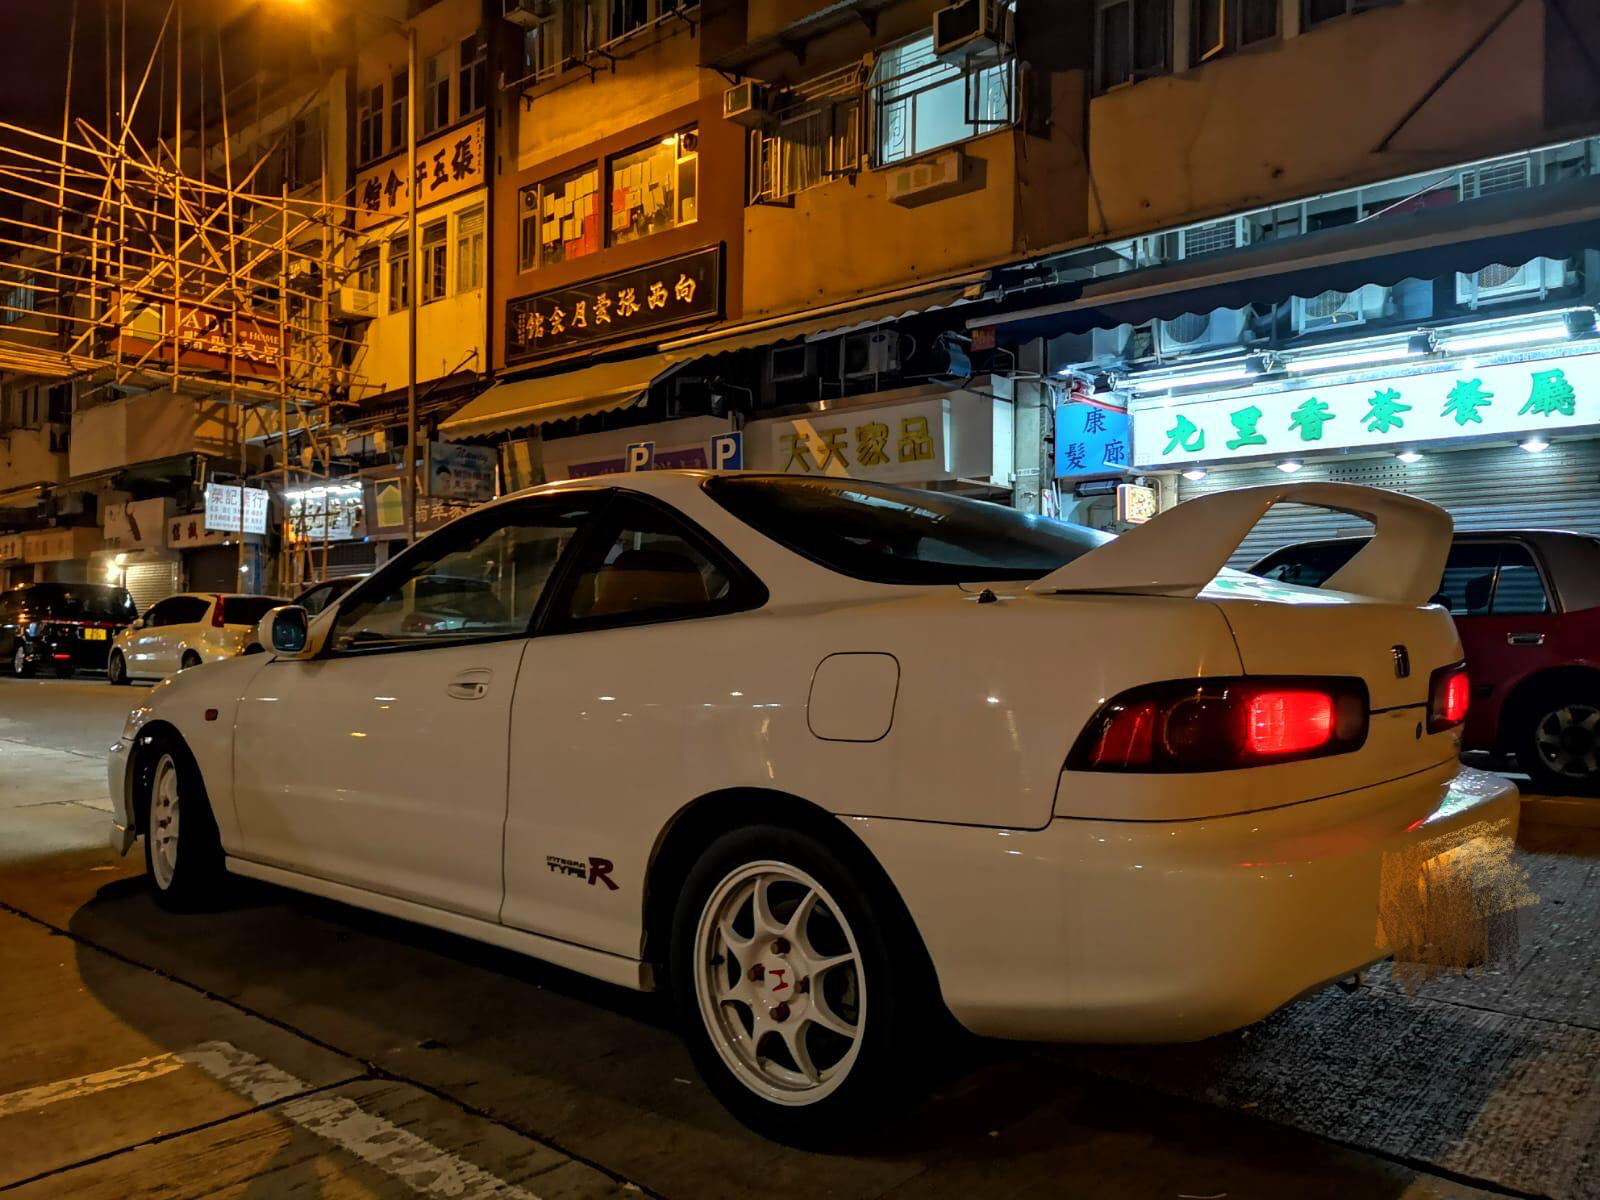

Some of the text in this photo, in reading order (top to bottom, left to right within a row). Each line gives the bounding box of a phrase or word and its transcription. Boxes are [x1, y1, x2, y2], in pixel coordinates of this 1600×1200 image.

[1162, 368, 1576, 456] 九里香茶餐廳
[630, 447, 649, 472] P
[716, 438, 736, 470] P
[779, 416, 935, 473] 天天家品
[546, 856, 586, 868] INTEGRA
[547, 856, 620, 891] TYPE R
